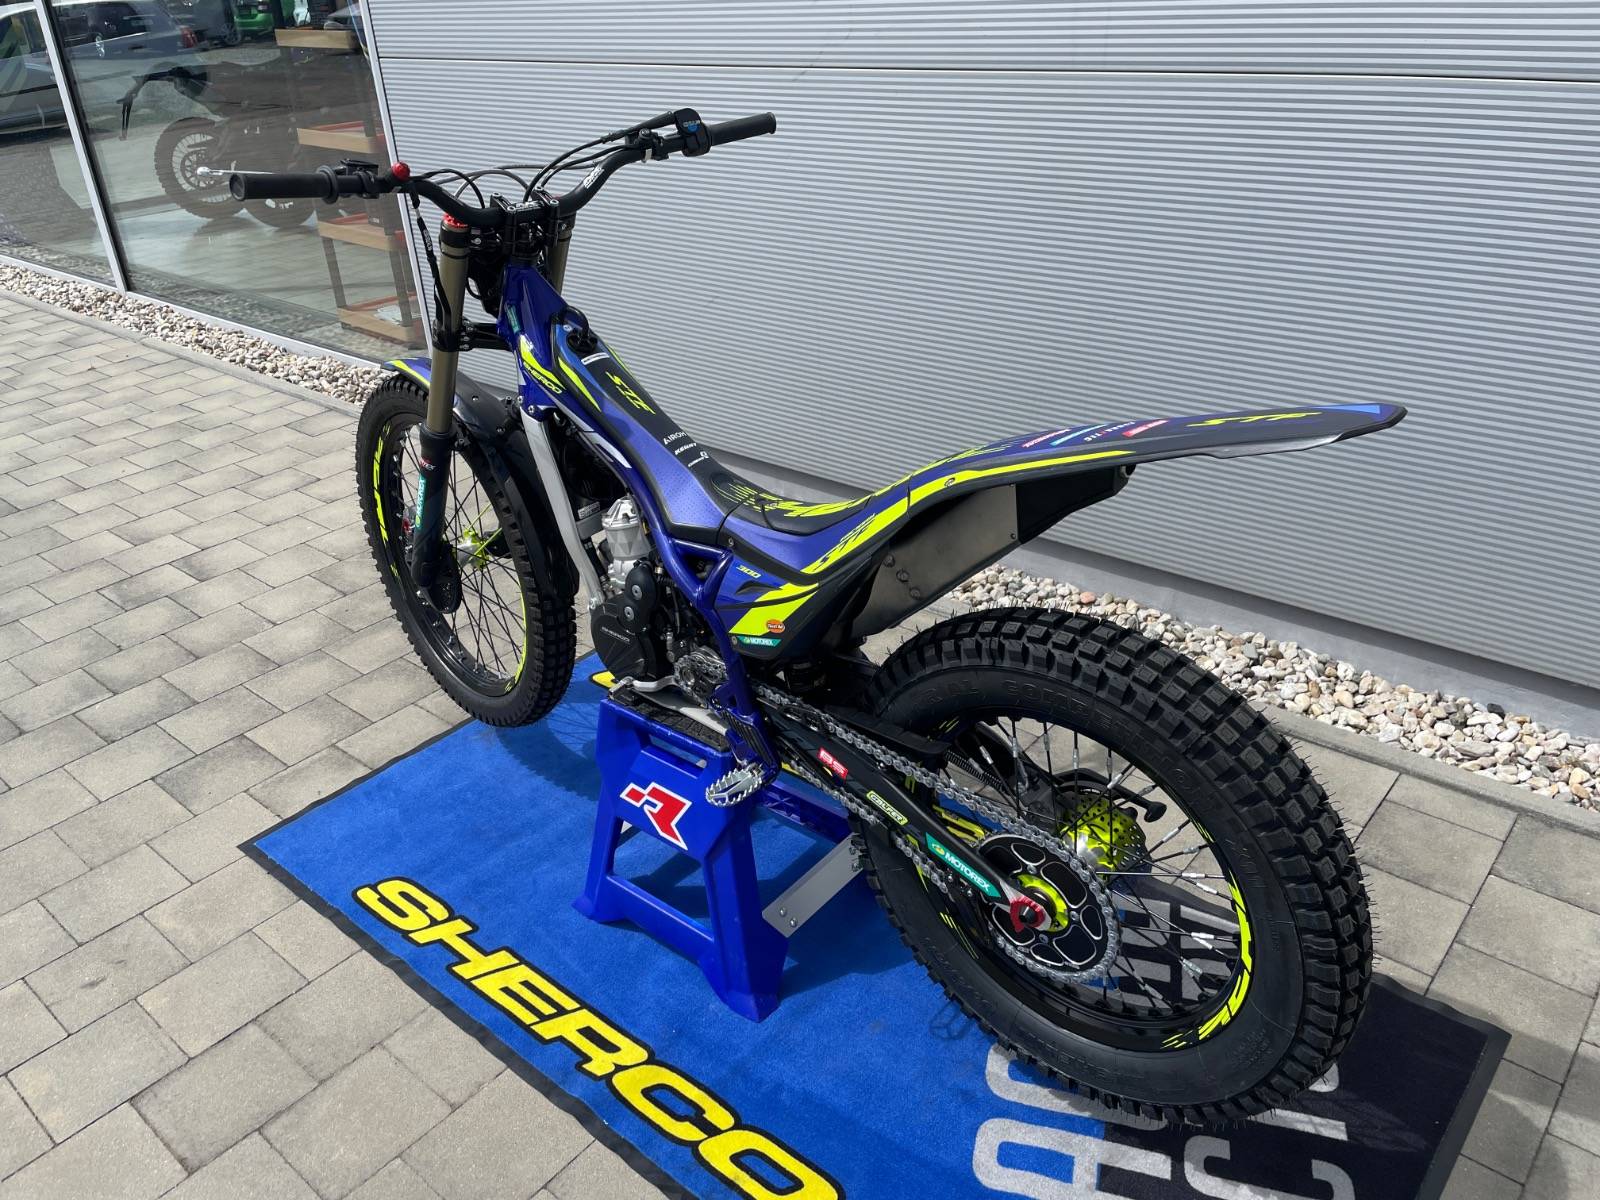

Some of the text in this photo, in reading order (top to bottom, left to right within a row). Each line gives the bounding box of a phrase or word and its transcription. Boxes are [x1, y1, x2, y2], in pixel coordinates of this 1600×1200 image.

[523, 360, 562, 394] SHERCO
[663, 432, 687, 445] AIROH
[944, 851, 991, 893] MOTOREX
[353, 877, 846, 1200] SHERCO
